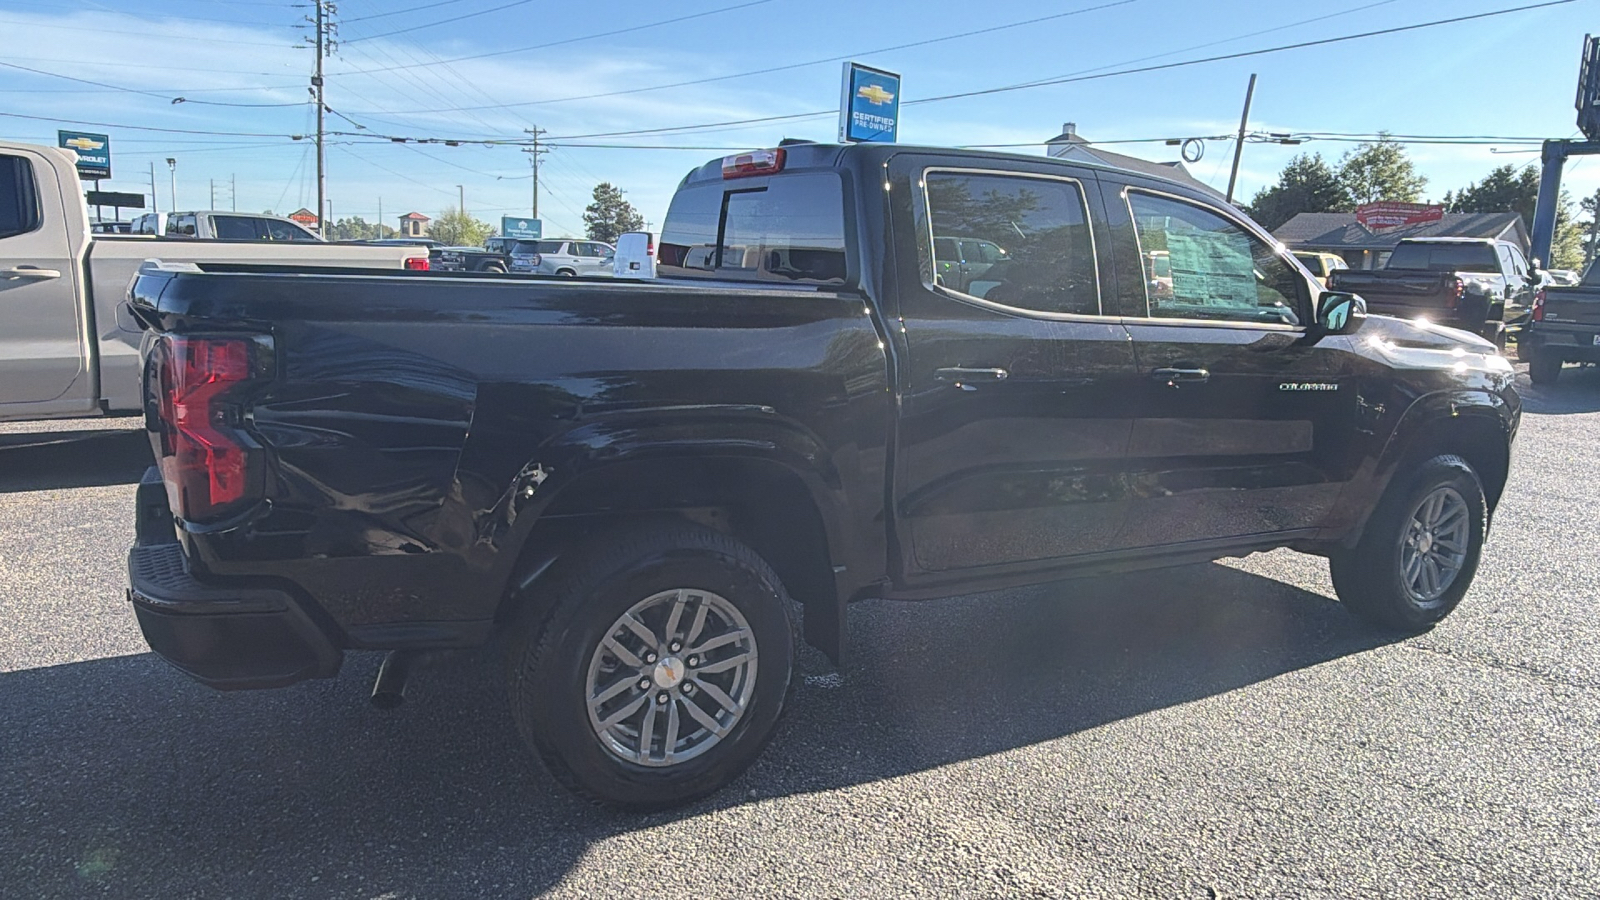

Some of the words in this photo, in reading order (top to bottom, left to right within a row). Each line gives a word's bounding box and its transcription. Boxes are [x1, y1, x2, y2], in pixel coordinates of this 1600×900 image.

[853, 111, 894, 126] CERTIFIED
[854, 119, 893, 132] PRE-OWNED
[78, 155, 107, 164] VROLET
[1279, 383, 1339, 391] COLORADO
